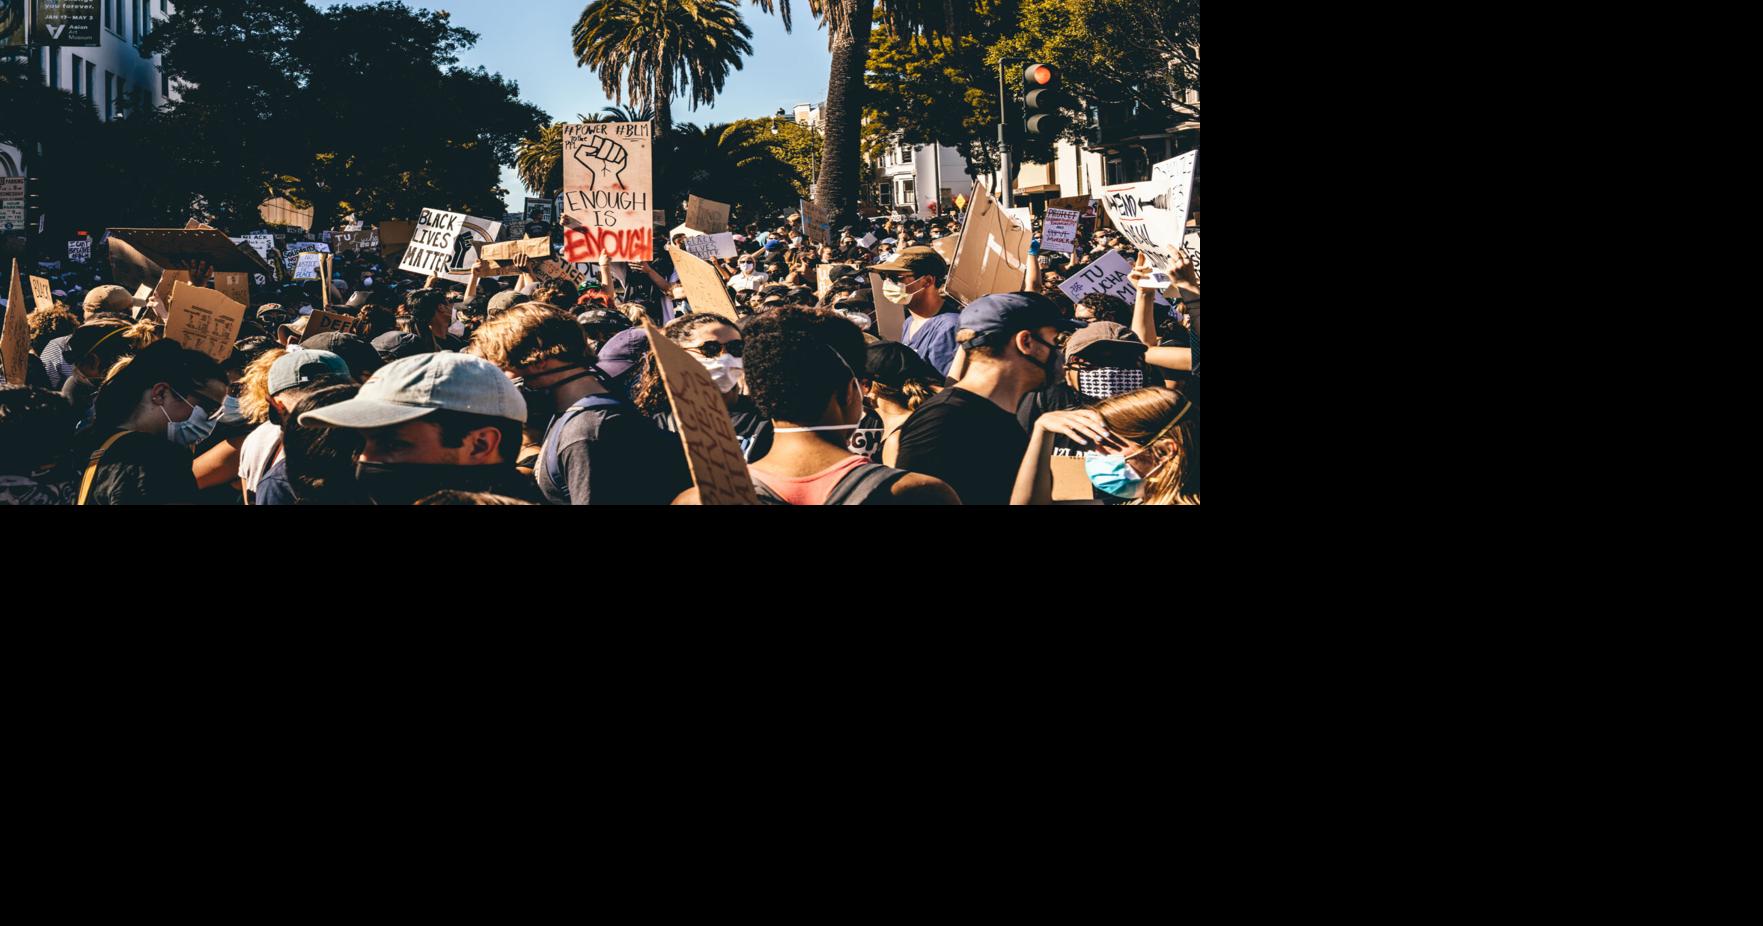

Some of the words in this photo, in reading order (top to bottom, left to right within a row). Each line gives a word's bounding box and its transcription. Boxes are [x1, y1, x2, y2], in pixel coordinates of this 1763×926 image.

[563, 124, 608, 136] #POWER
[615, 123, 649, 137] #BLM
[565, 189, 647, 212] ENOUGH
[418, 209, 458, 231] BLACK
[594, 210, 617, 228] IS
[412, 227, 451, 249] LIVES
[564, 226, 653, 262] ENOUGH
[402, 245, 453, 273] MATTER
[1080, 265, 1104, 283] TU
